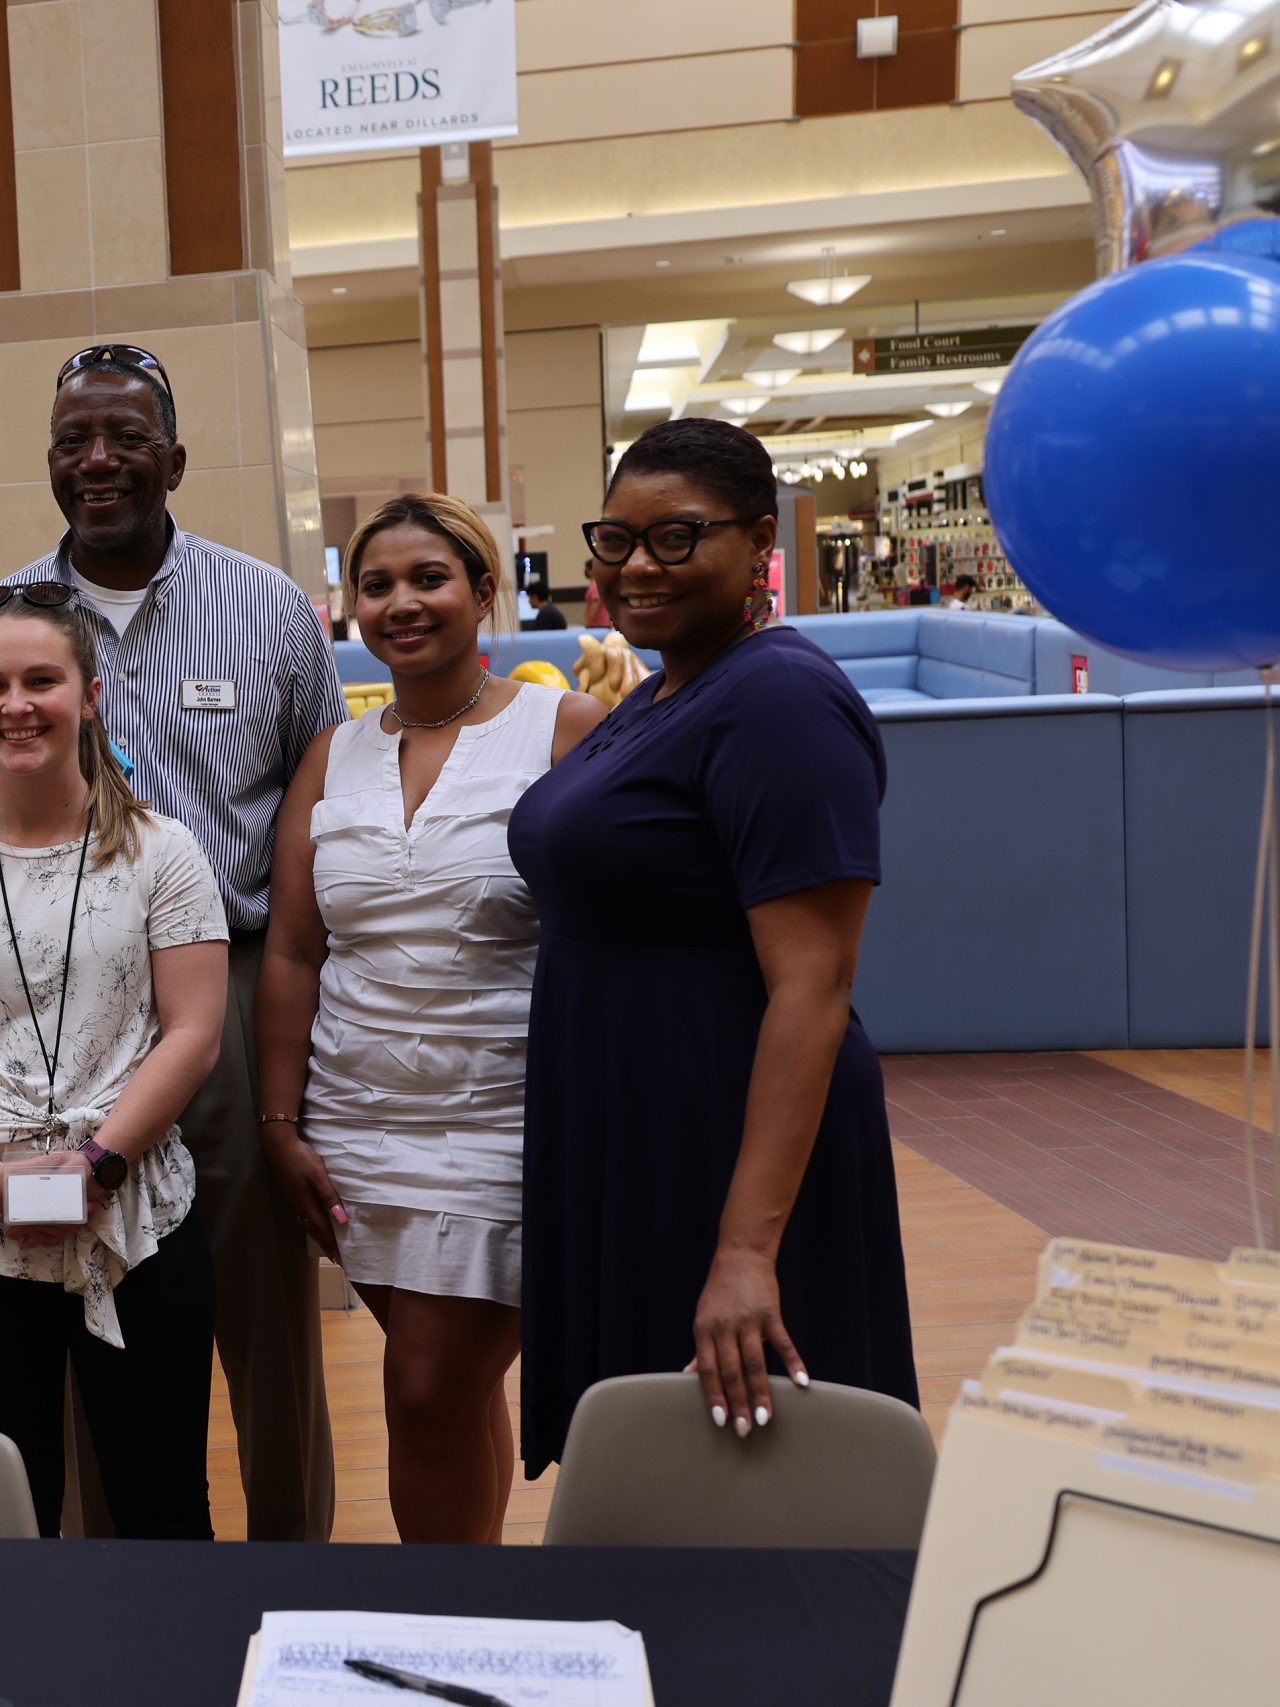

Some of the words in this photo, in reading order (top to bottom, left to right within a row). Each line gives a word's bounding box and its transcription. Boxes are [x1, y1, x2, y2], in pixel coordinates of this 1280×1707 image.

[319, 68, 443, 110] REEDS
[286, 124, 352, 140] LOCATED
[360, 120, 399, 133] NEAR
[406, 112, 480, 130] DILLARDS
[890, 337, 920, 351] Food
[923, 335, 961, 348] Court
[890, 354, 932, 369] Family
[936, 350, 1002, 367] Restrooms
